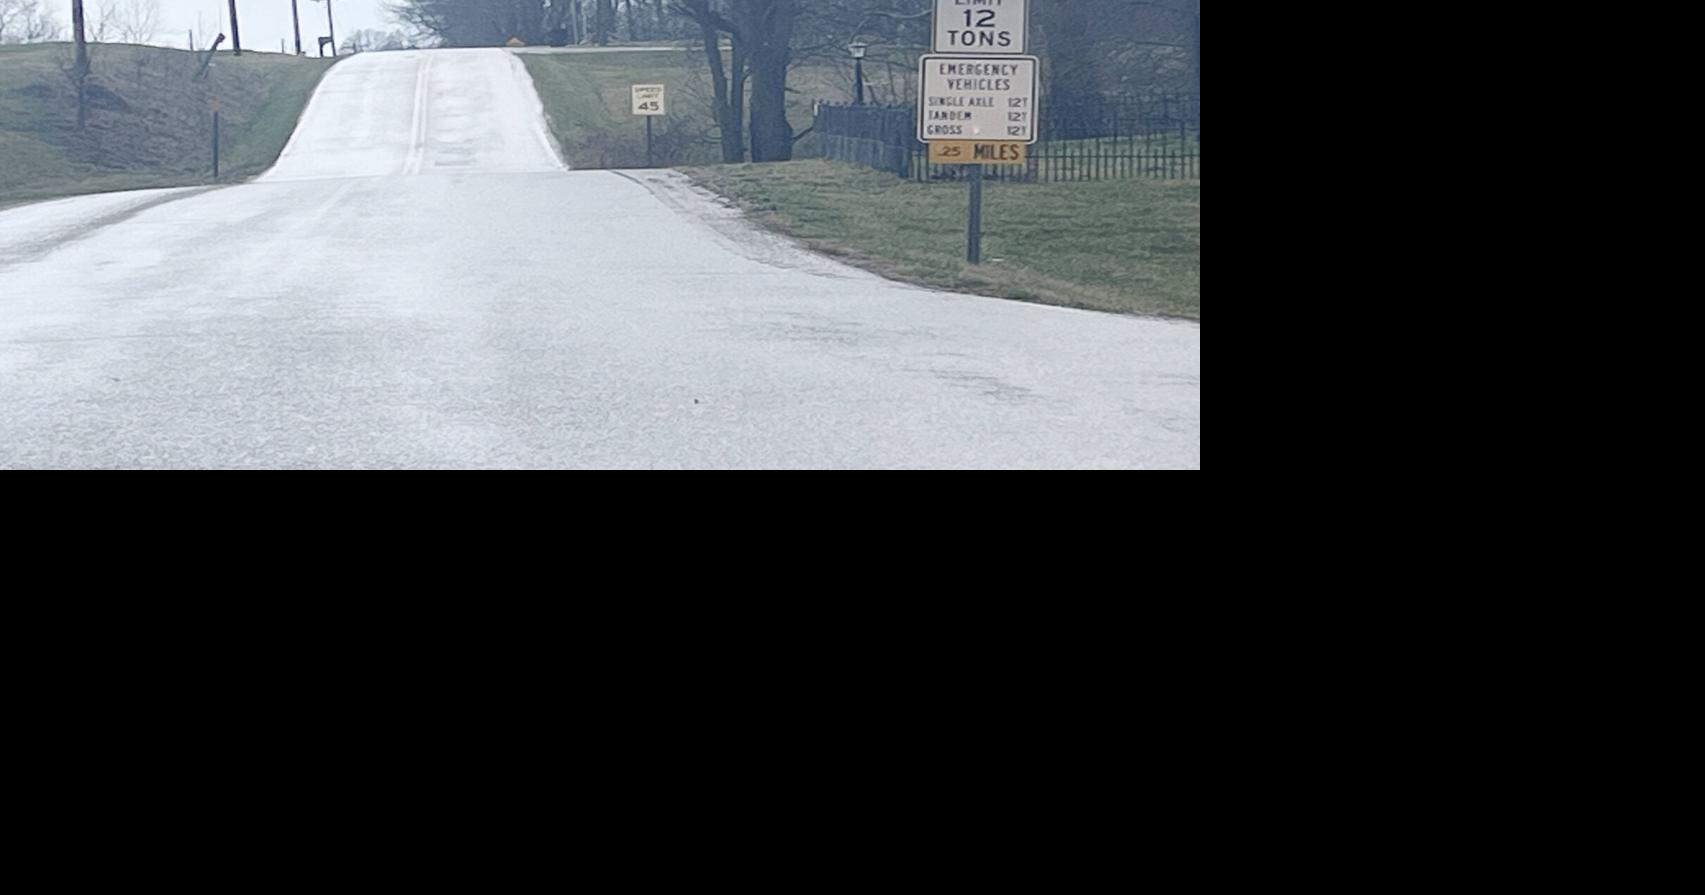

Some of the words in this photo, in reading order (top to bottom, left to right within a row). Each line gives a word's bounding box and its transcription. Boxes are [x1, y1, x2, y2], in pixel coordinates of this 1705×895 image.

[963, 9, 996, 27] 12
[947, 30, 1011, 46] TONS
[940, 63, 1018, 76] EMERGENCY
[947, 79, 1010, 91] VEHICLES
[638, 101, 660, 111] 45
[928, 96, 963, 107] SINGLE
[968, 97, 994, 107] AXLE
[1008, 97, 1028, 108] 12T
[928, 110, 972, 121] TANDEM
[1008, 111, 1027, 122] 12T
[927, 125, 962, 135] GROSS
[1008, 126, 1026, 136] 12T
[974, 144, 1019, 161] MILES
